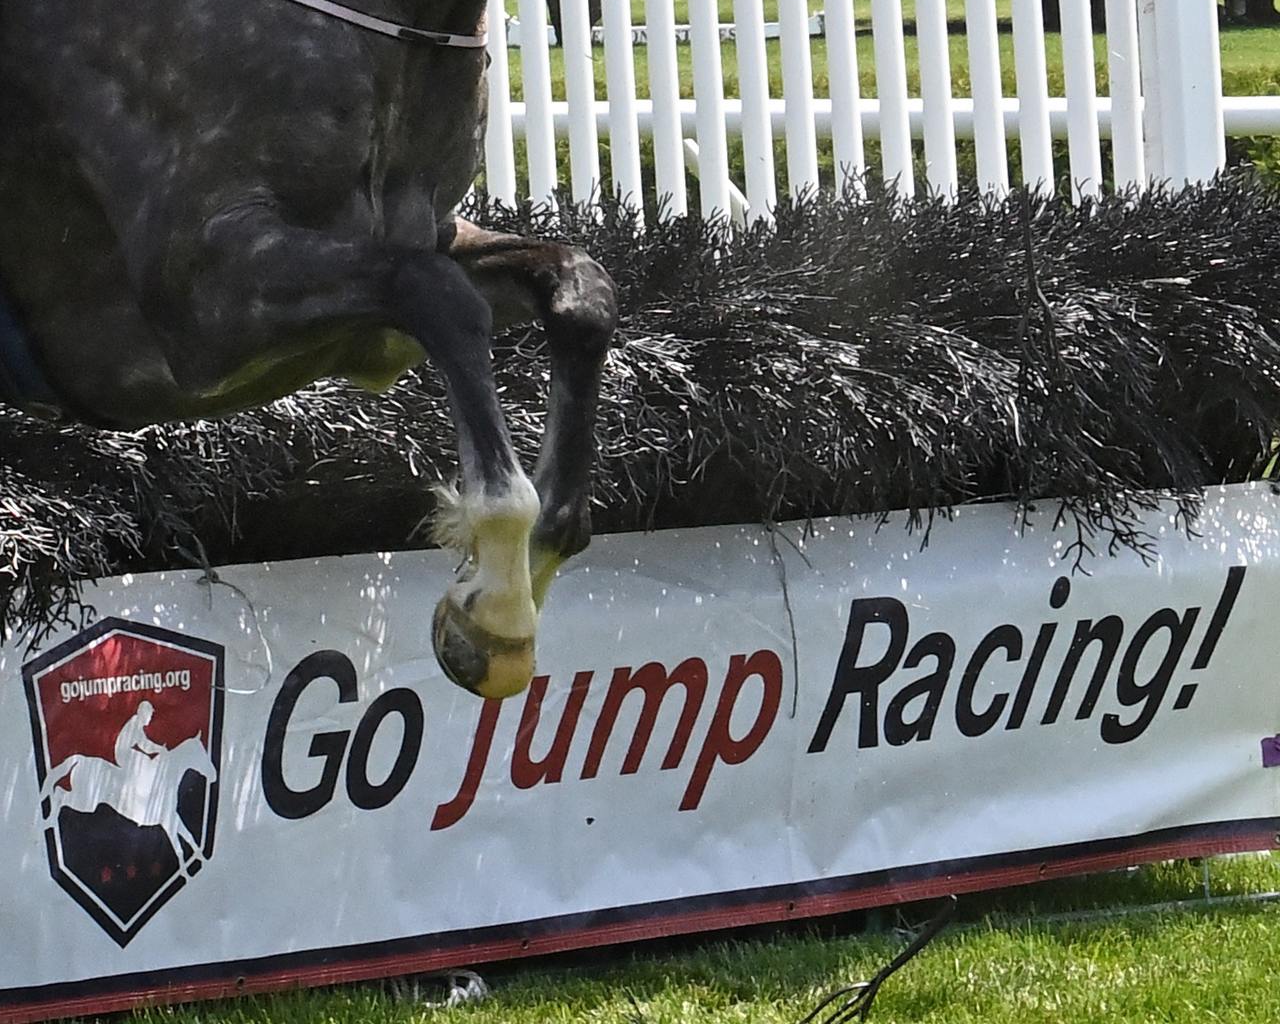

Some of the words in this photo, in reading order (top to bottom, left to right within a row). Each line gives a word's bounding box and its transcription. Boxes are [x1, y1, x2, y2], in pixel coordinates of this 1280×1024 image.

[60, 669, 192, 703] gojumpracing.org
[261, 648, 424, 820] Go
[808, 566, 1246, 754] Racing!
